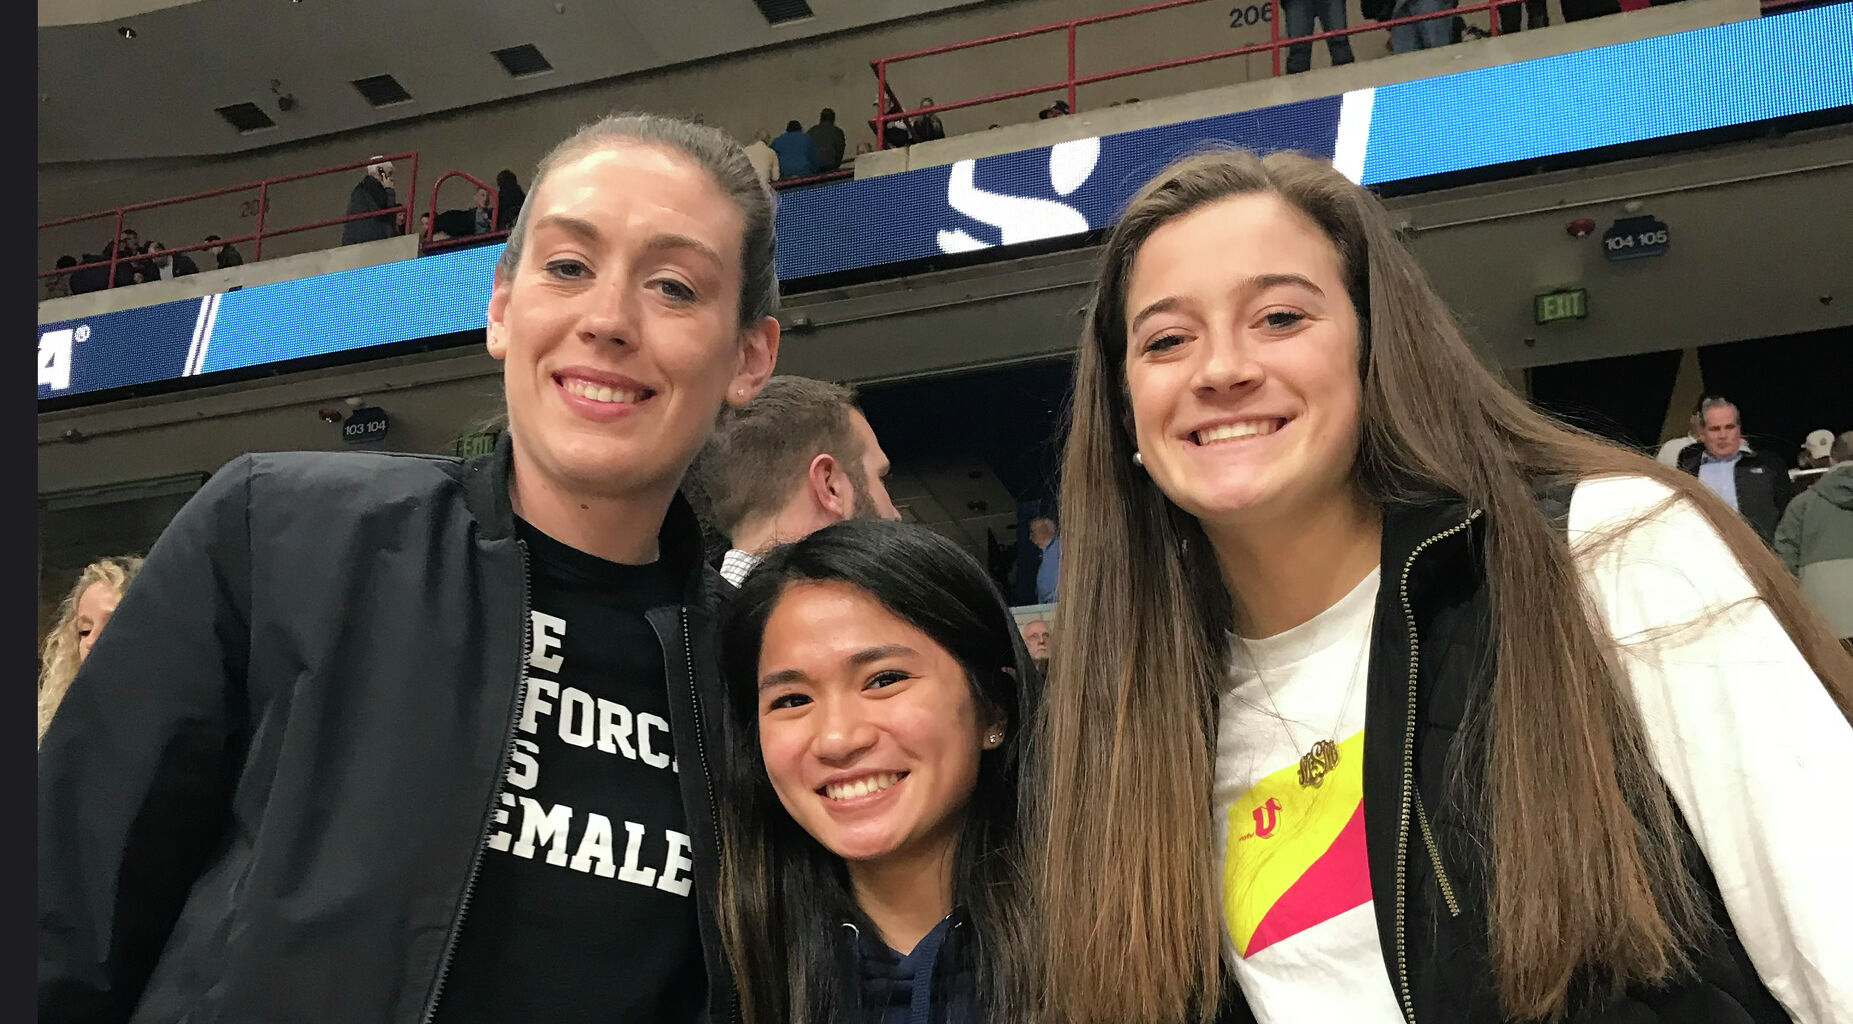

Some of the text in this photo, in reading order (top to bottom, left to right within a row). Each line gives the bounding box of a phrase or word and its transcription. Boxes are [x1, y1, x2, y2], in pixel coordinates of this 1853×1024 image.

[1605, 230, 1668, 250] 104 105
[1543, 292, 1581, 320] EXIT
[344, 420, 386, 436] 103 104
[518, 676, 680, 774] FORC
